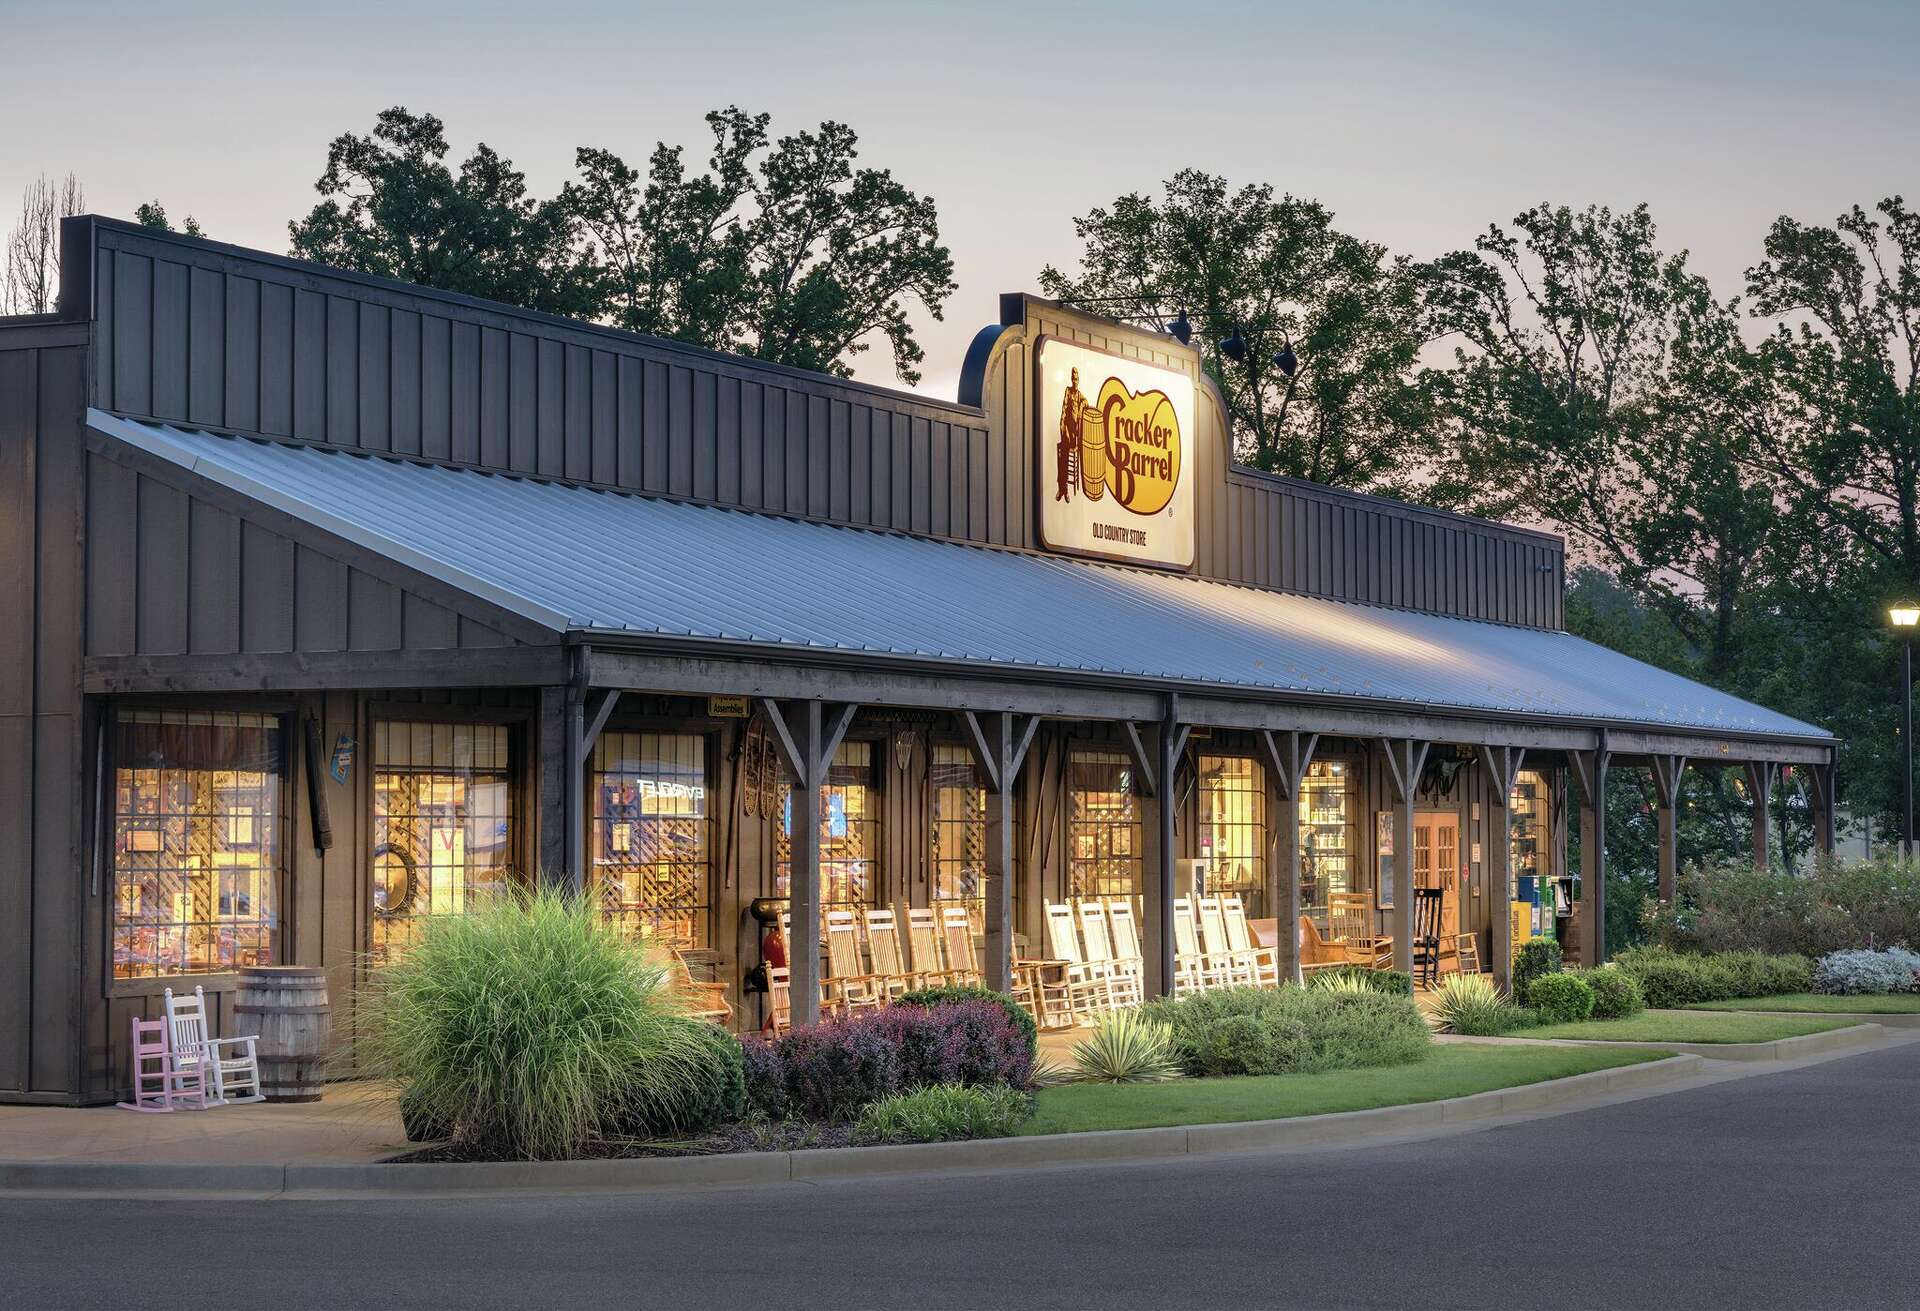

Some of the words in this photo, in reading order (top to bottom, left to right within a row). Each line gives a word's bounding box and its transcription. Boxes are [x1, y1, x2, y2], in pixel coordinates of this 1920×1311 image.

[1103, 394, 1172, 468] Cracker
[1115, 441, 1173, 505] Barrel
[1092, 522, 1103, 538] OLD
[1104, 525, 1129, 543] COUNTRY
[1130, 529, 1147, 546] STORE
